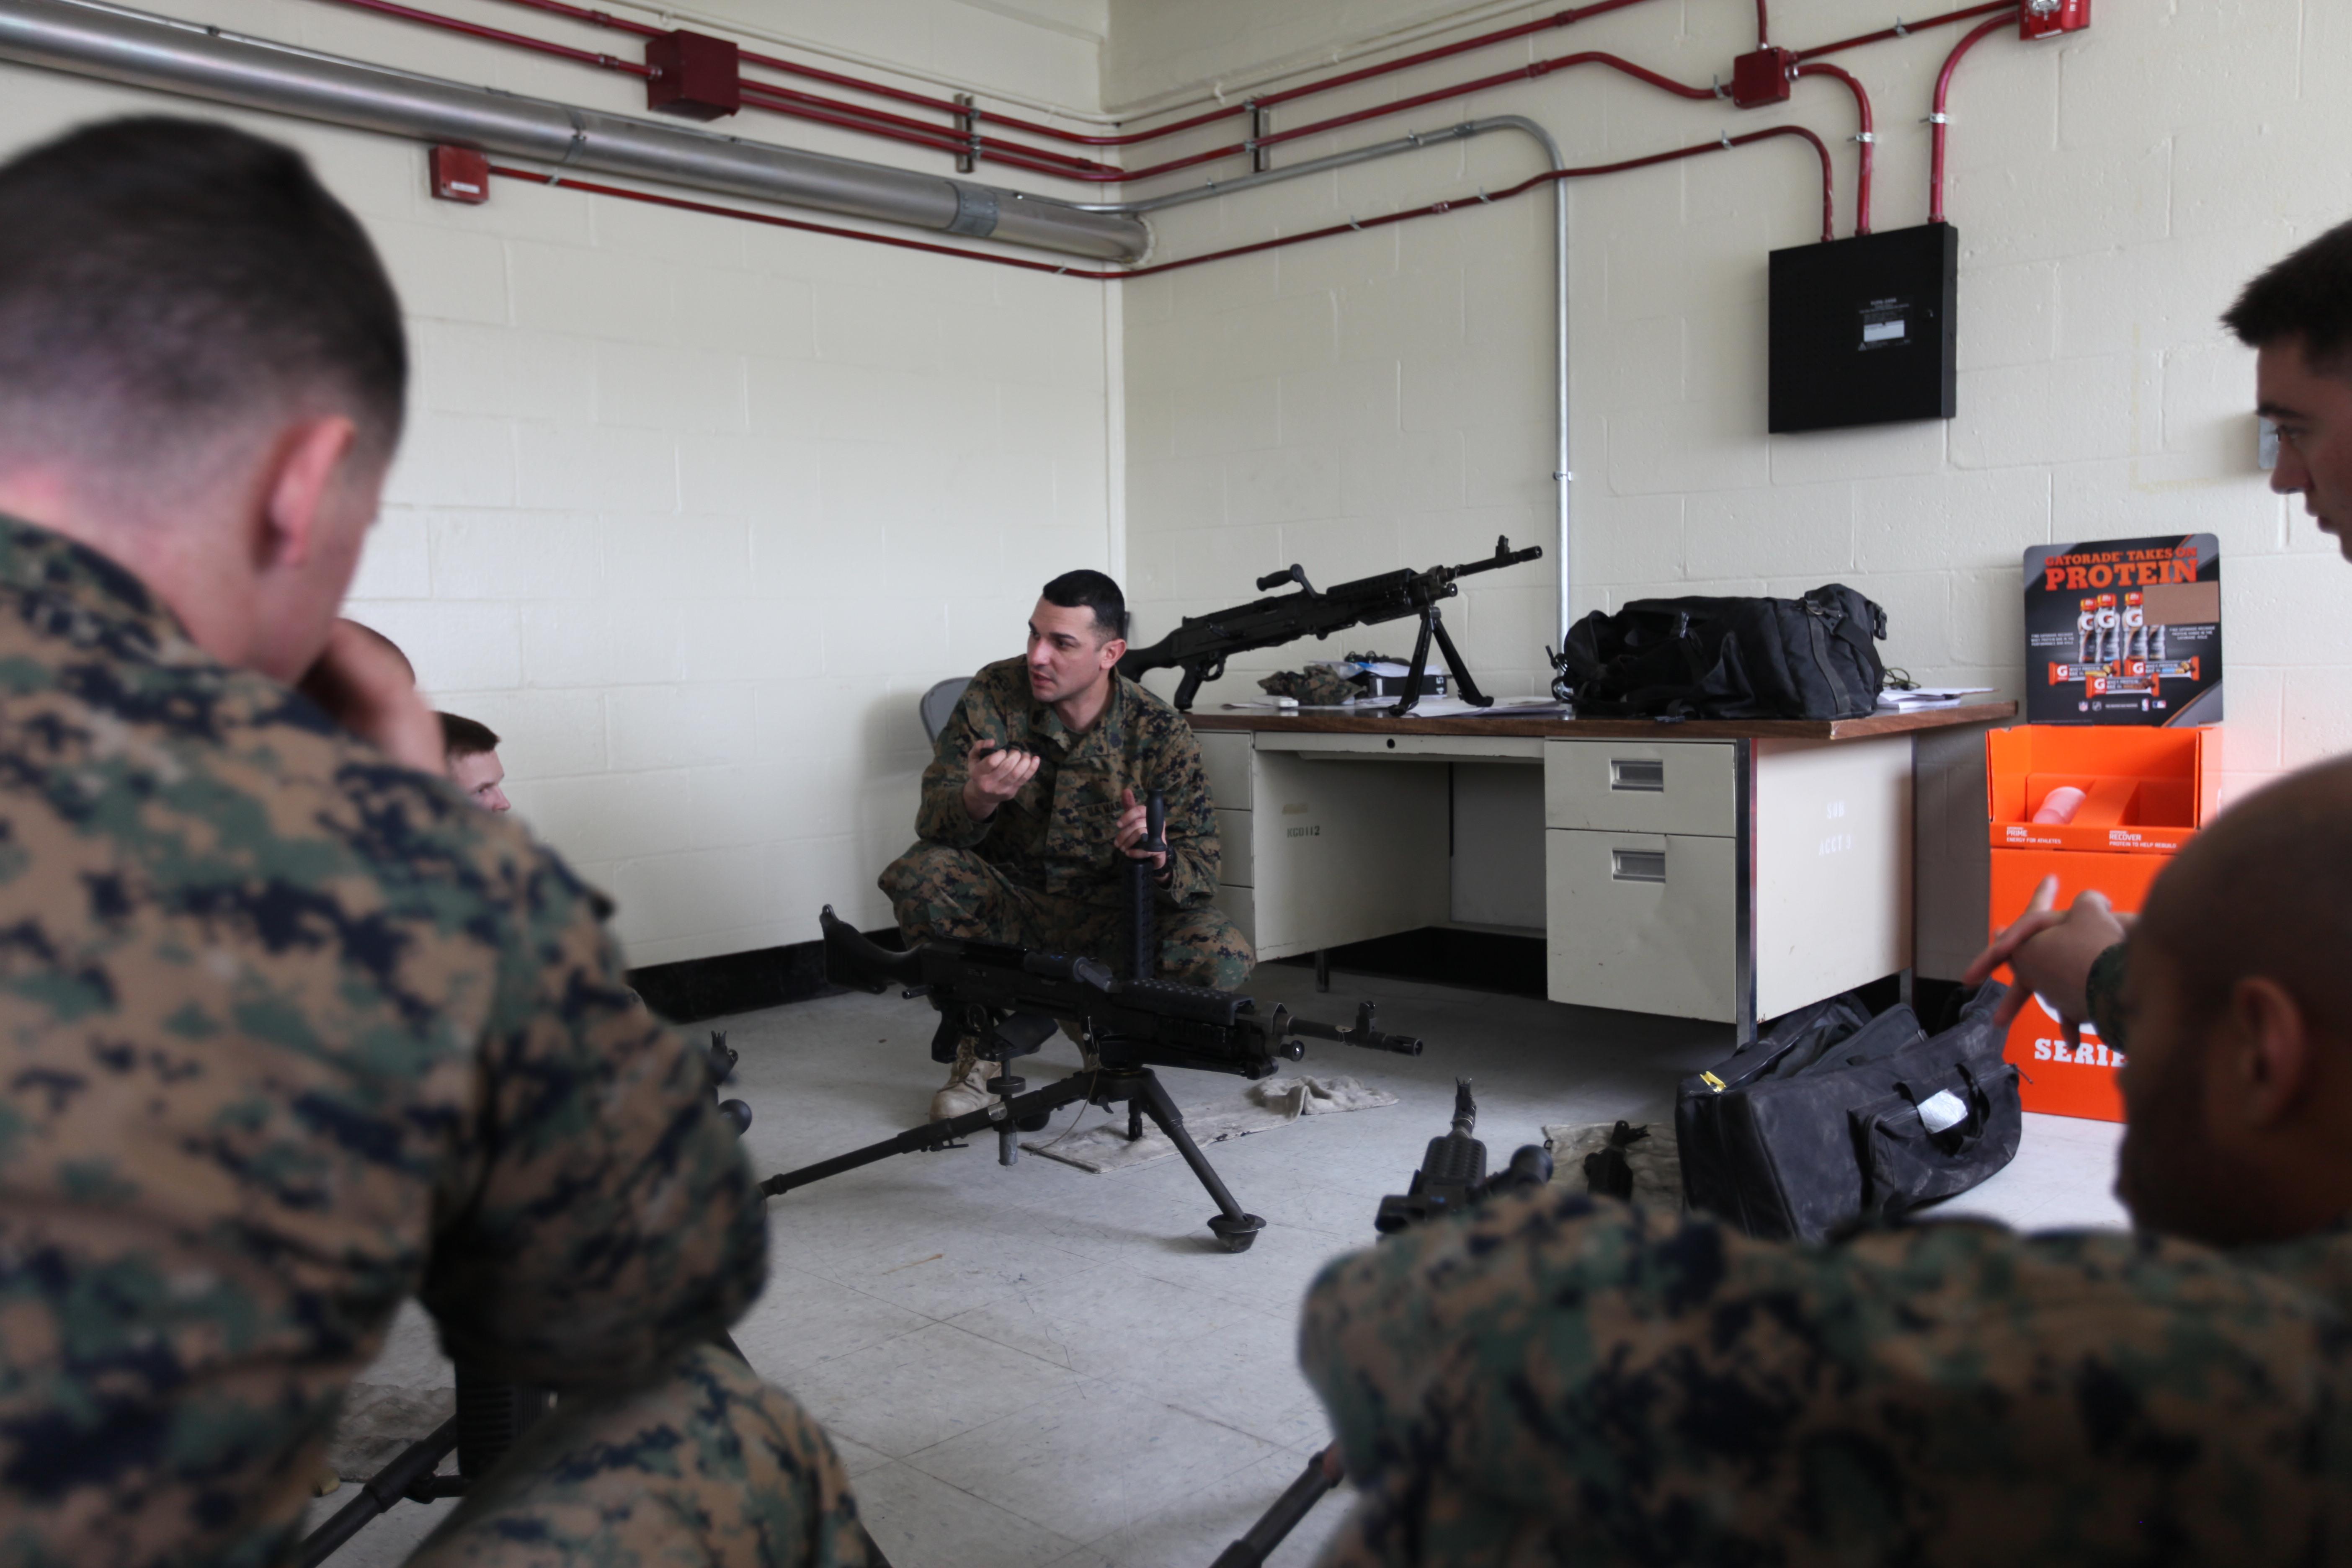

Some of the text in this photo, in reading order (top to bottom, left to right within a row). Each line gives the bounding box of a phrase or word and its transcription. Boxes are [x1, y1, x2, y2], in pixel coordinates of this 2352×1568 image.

[2045, 546, 2197, 566] GATORADE TAKES ON
[2045, 559, 2198, 591] PROTEIN
[2034, 1038, 2126, 1068] SERIE
